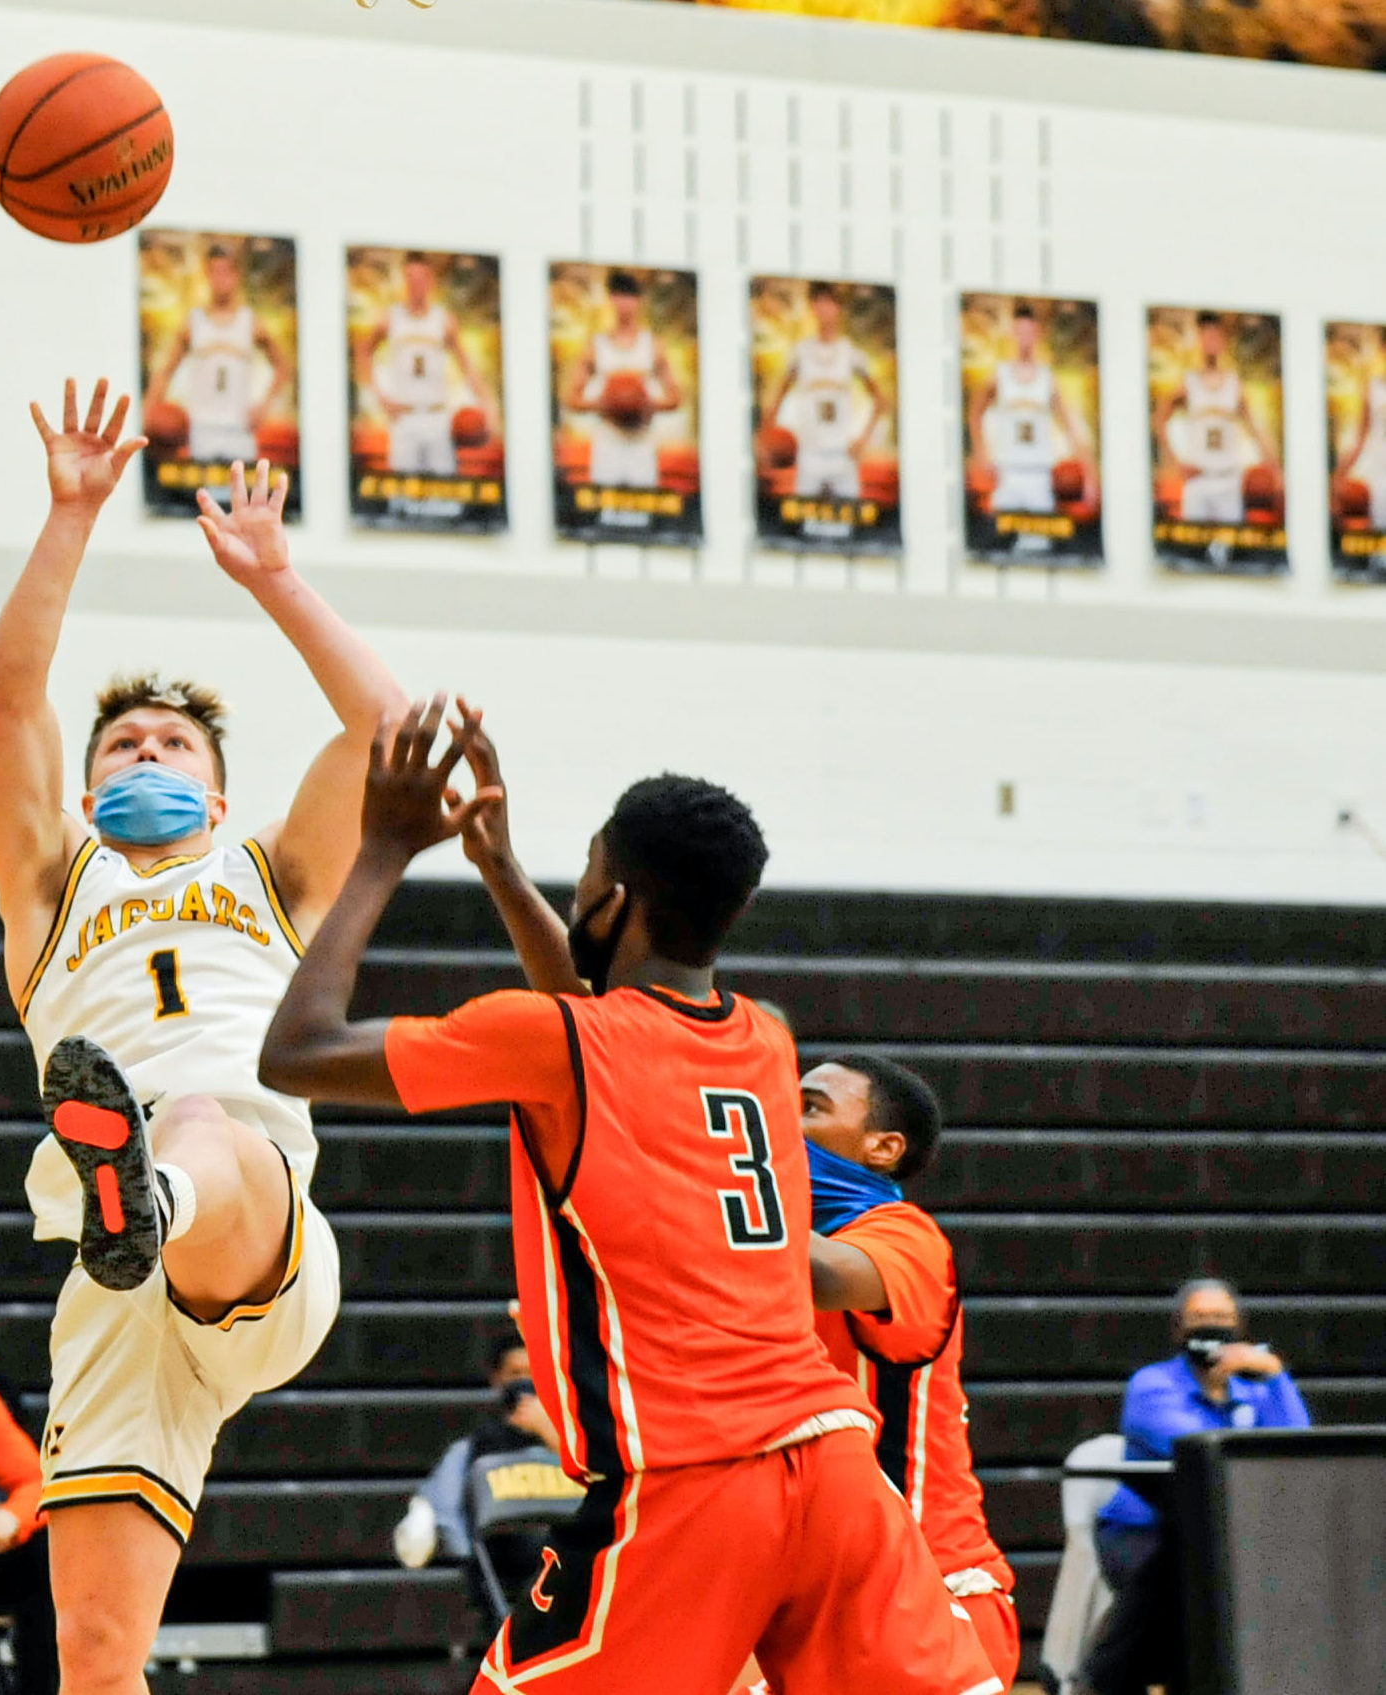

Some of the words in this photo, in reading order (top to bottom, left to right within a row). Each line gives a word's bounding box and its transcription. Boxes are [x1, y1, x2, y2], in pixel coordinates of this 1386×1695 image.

[66, 880, 270, 972] JAGUARS
[146, 947, 190, 1021] 1
[699, 1085, 788, 1251] 3
